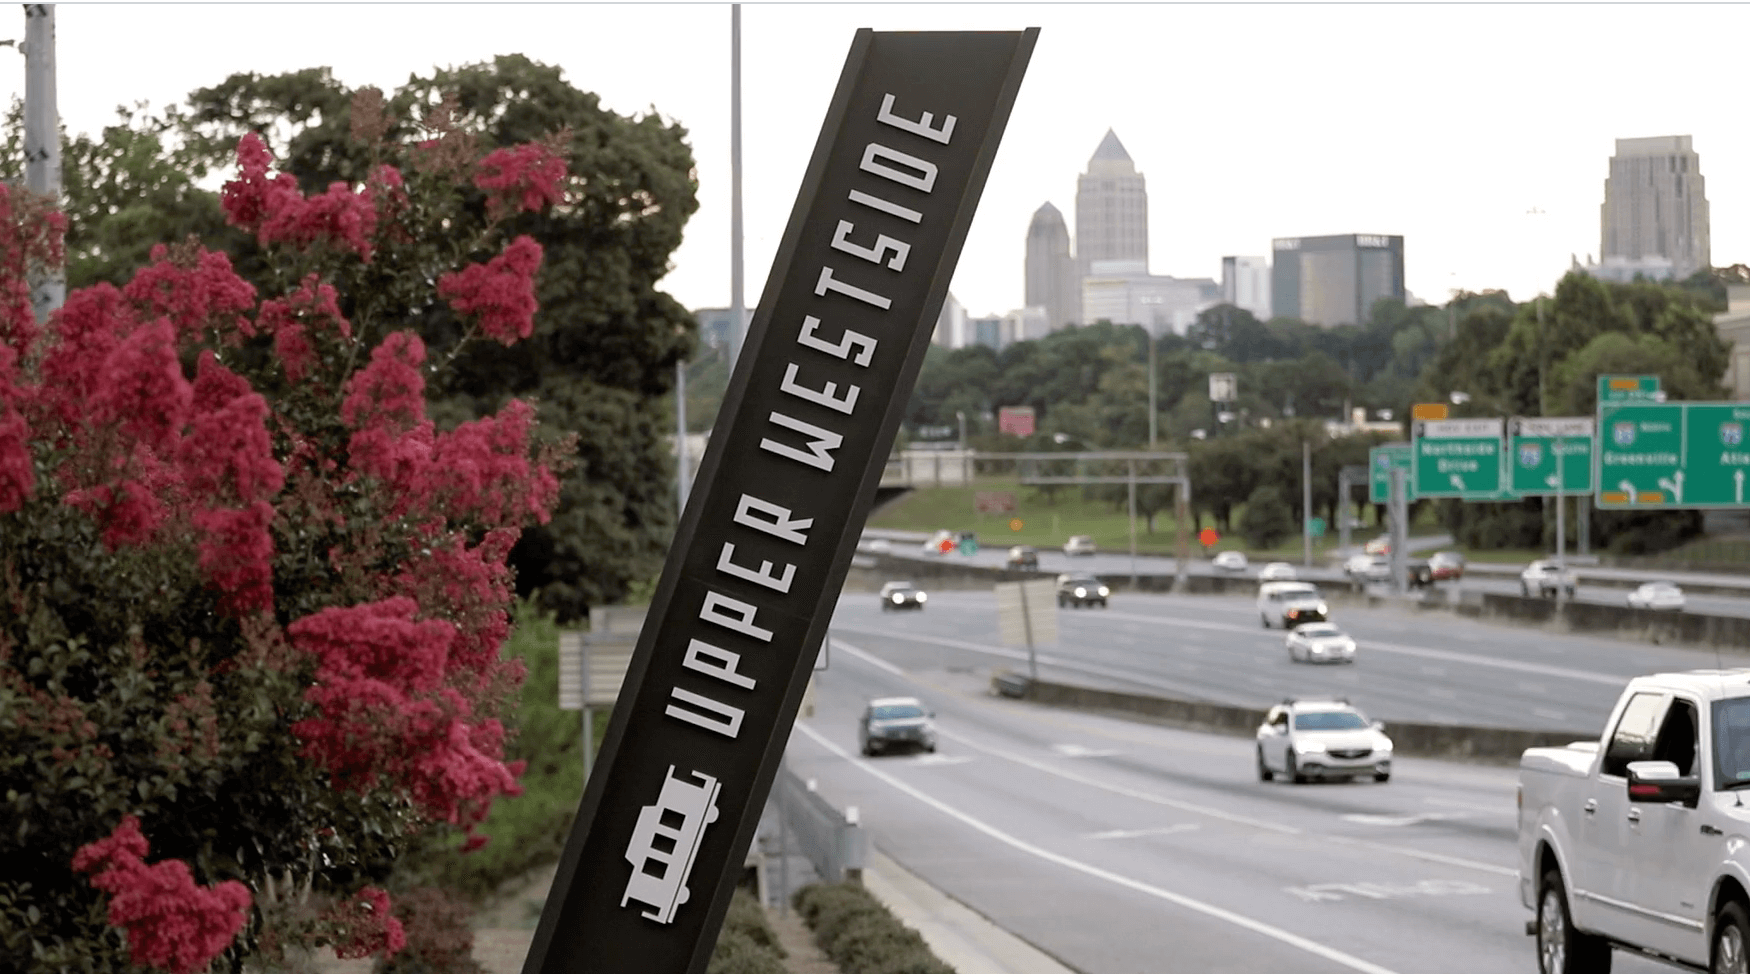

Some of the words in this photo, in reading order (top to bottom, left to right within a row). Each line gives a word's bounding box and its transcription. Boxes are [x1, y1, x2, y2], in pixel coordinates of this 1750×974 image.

[666, 494, 813, 738] UPPER
[760, 93, 957, 472] WESTSIDE
[1421, 442, 1495, 456] Northside
[1437, 458, 1478, 472] Drive
[1604, 451, 1677, 466] Greenville
